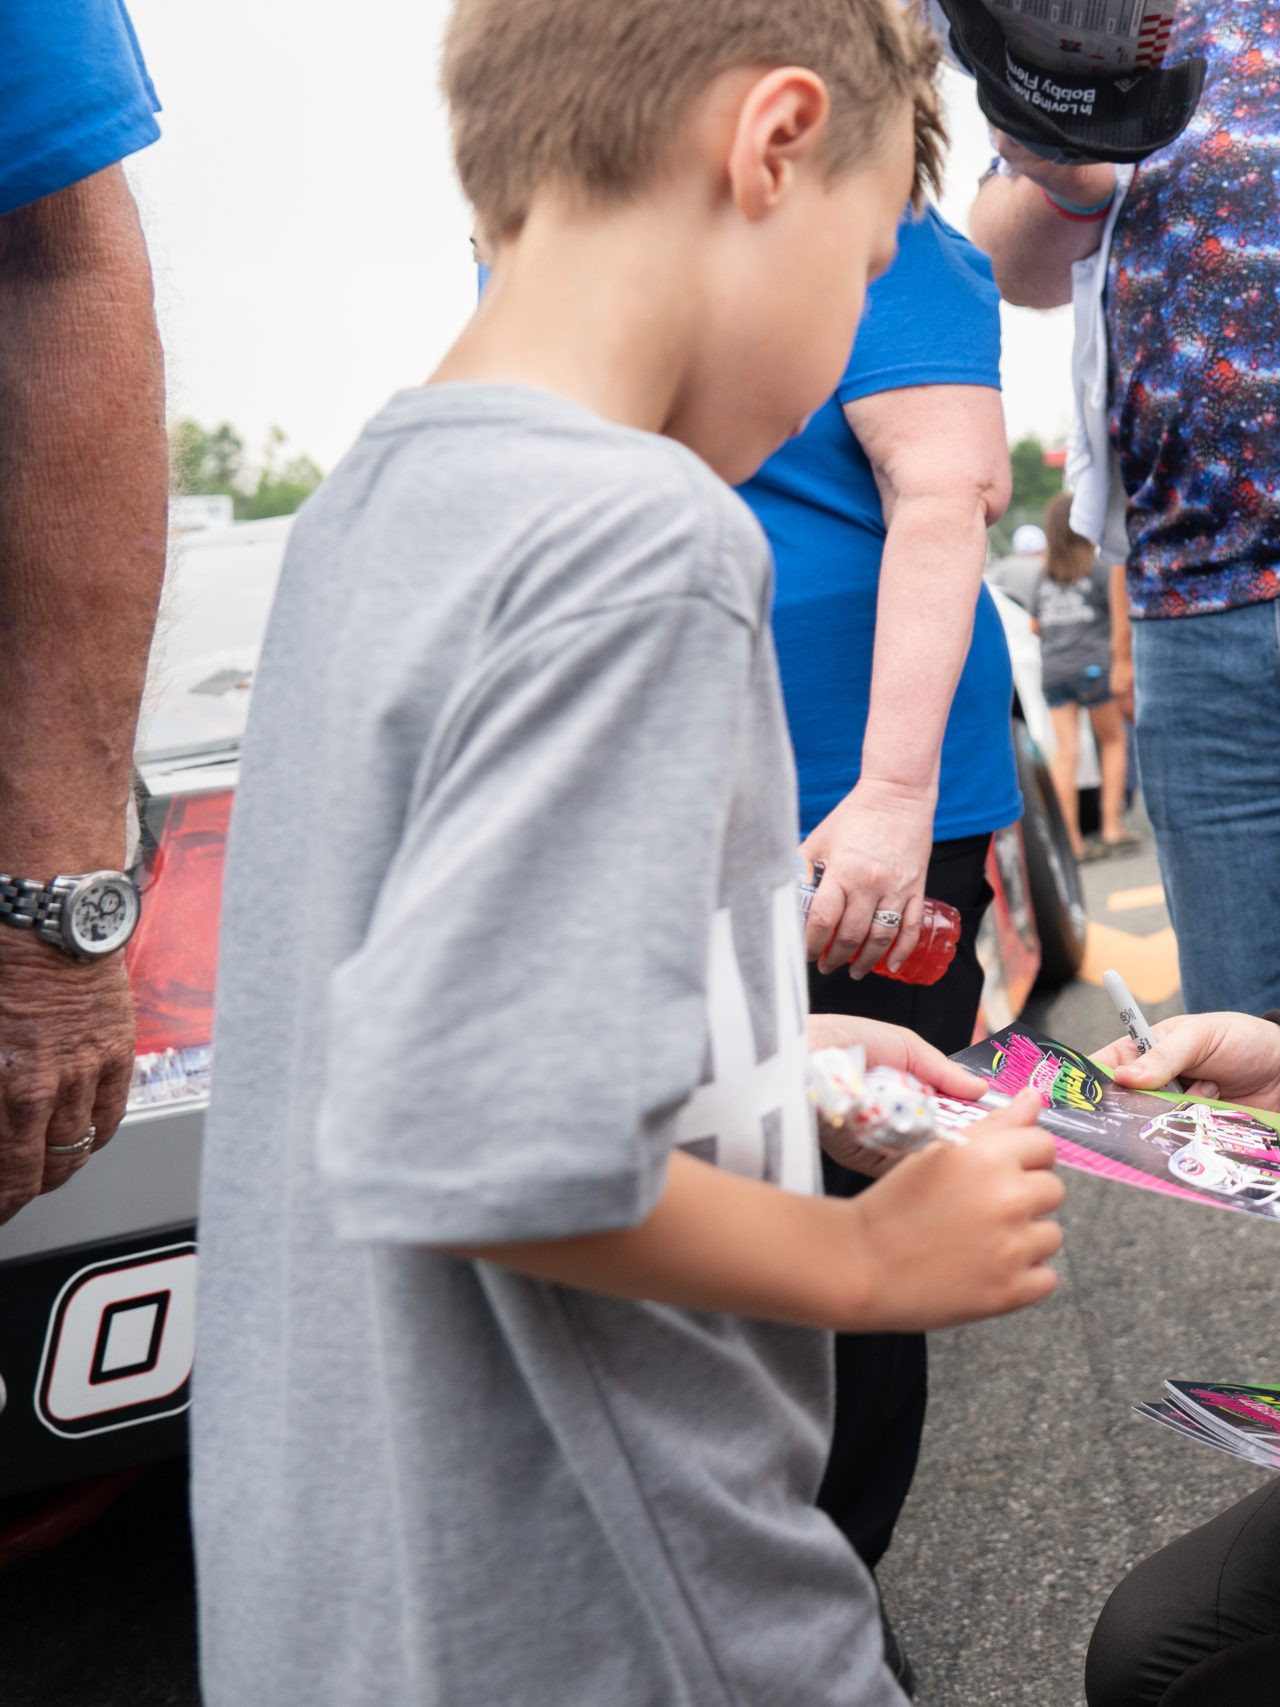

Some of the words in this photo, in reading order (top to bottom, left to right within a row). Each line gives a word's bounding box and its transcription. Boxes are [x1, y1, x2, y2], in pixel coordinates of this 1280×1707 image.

[1041, 79, 1097, 103] Bobby
[1031, 91, 1079, 116] Loving
[1080, 103, 1093, 116] In
